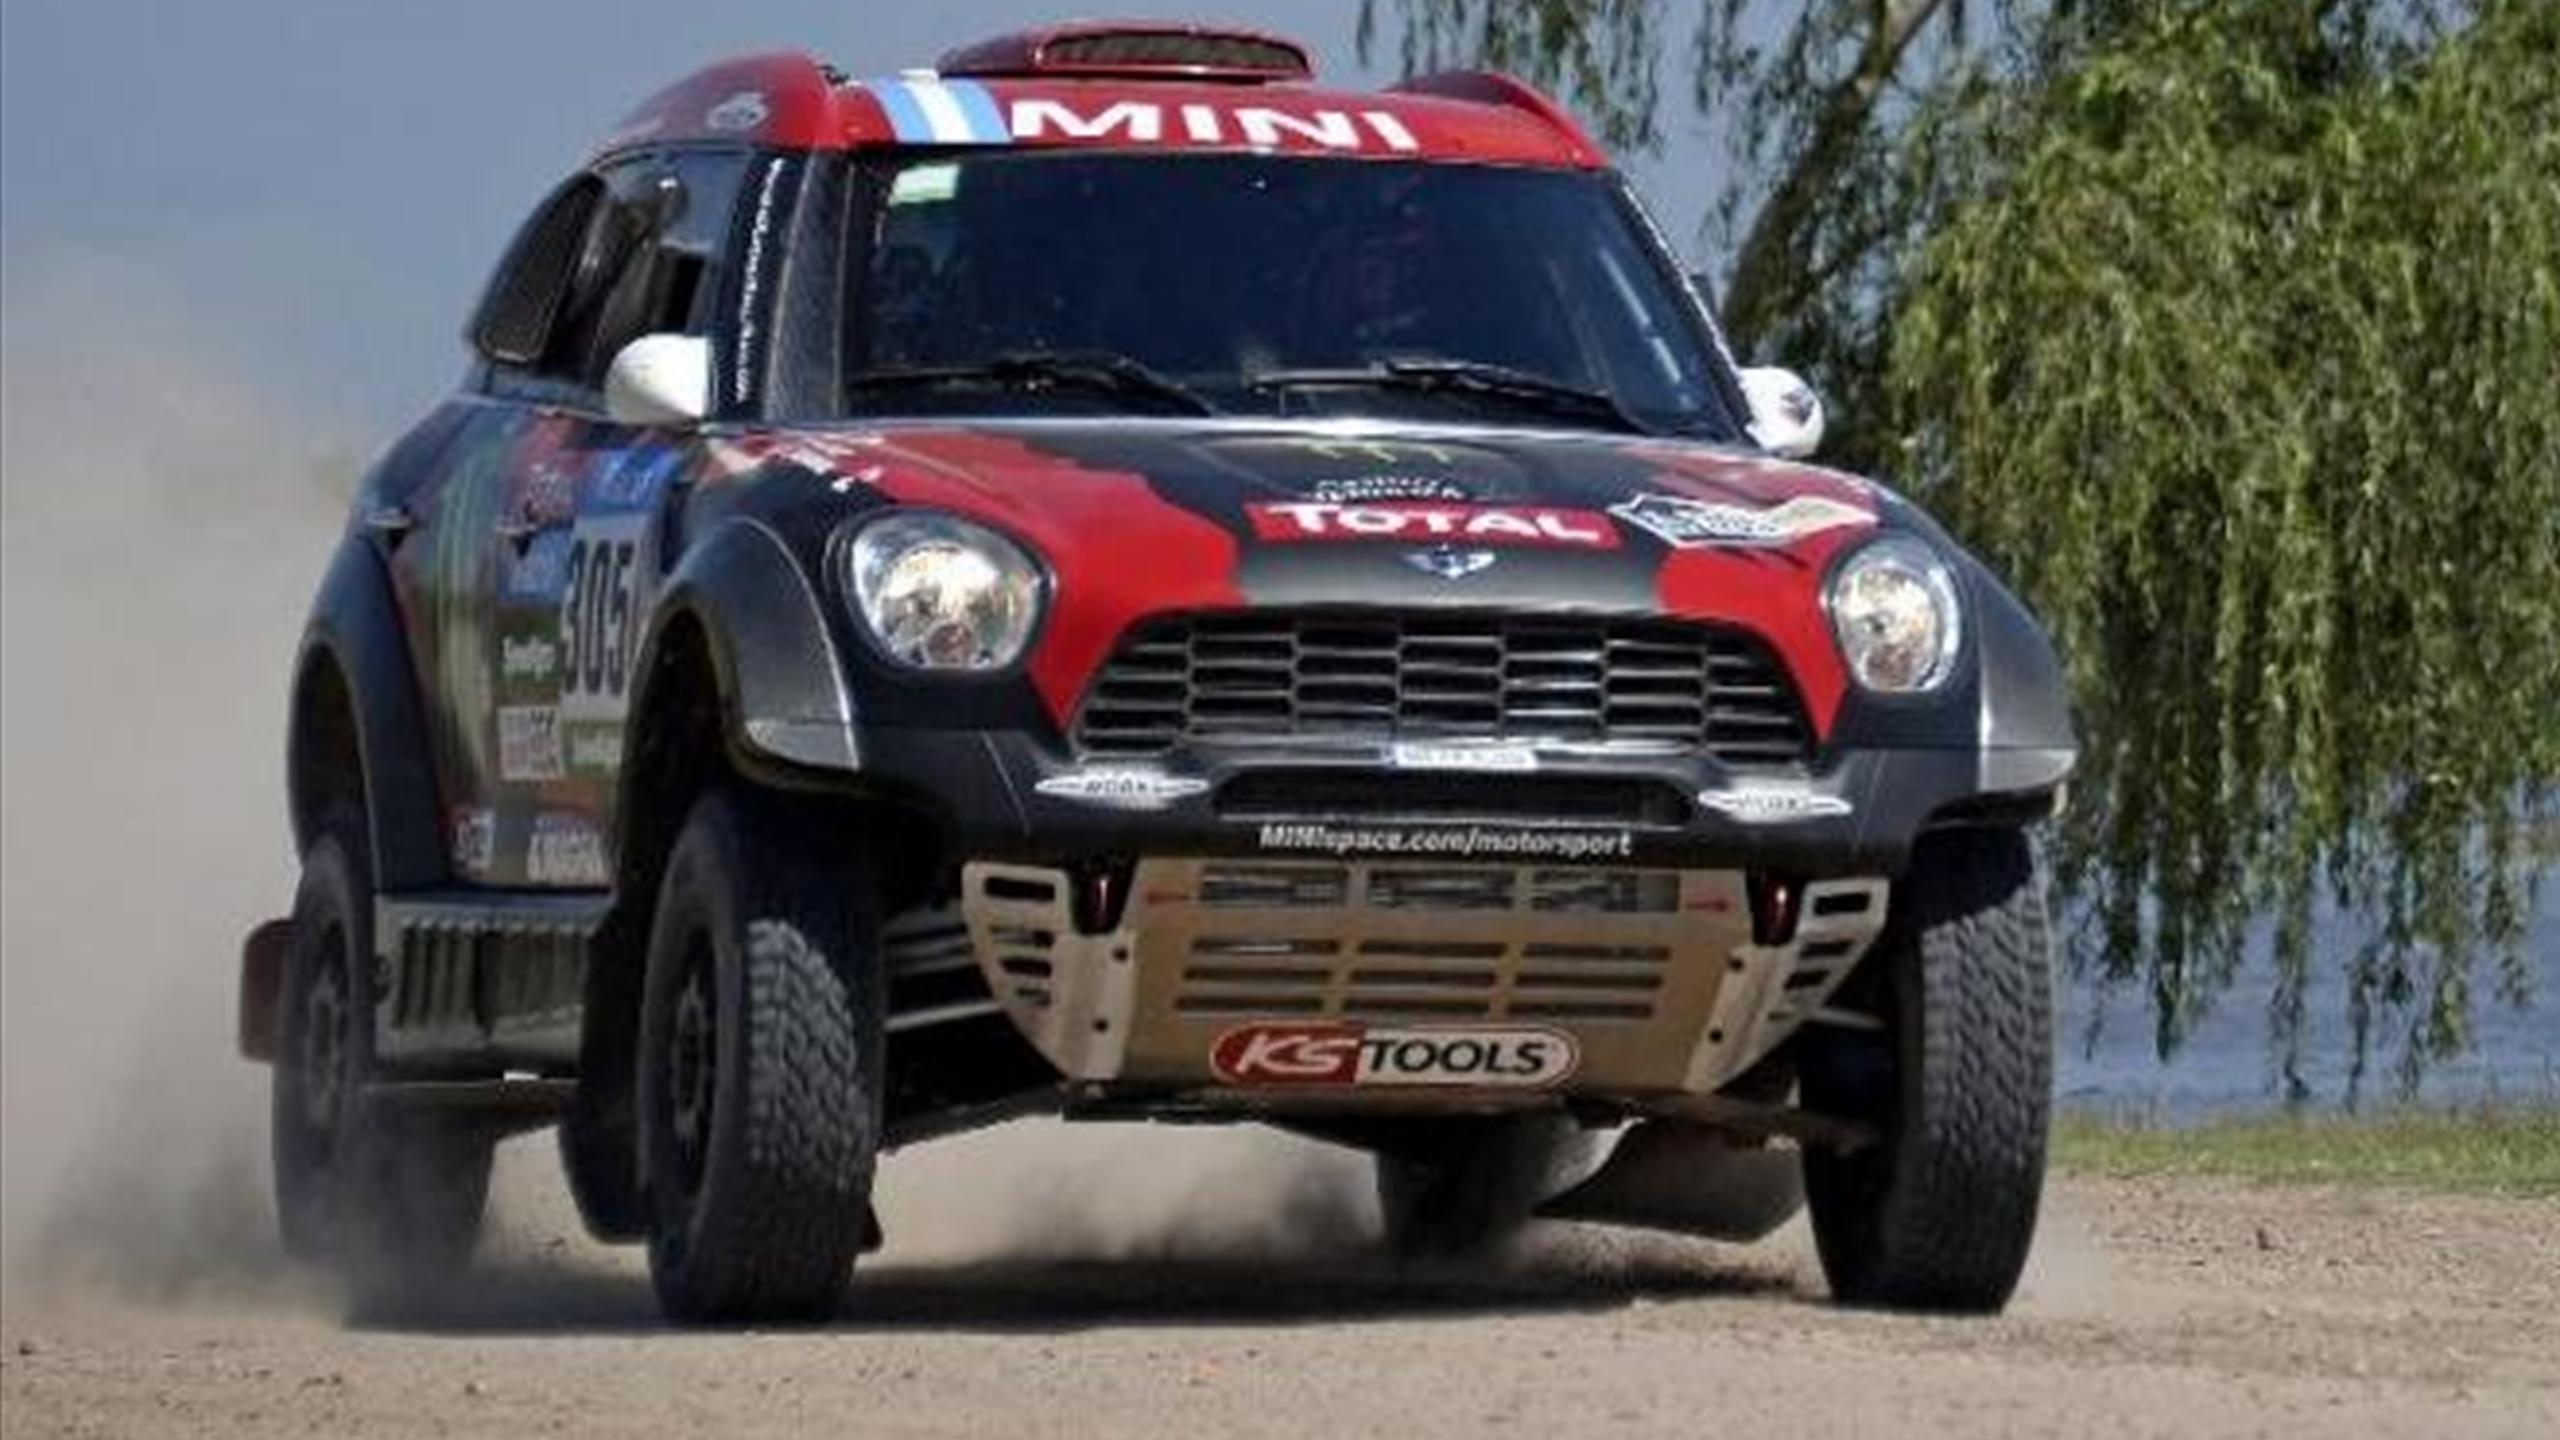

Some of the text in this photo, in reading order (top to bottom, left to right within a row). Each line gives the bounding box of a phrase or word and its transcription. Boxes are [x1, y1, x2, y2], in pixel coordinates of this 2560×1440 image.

[1011, 99, 1419, 152] MINI
[1266, 503, 1600, 542] TOTAL
[560, 538, 634, 697] 305
[1259, 823, 1633, 857] MINIspace.com/motorsport
[1360, 1038, 1547, 1075] TOOLS
